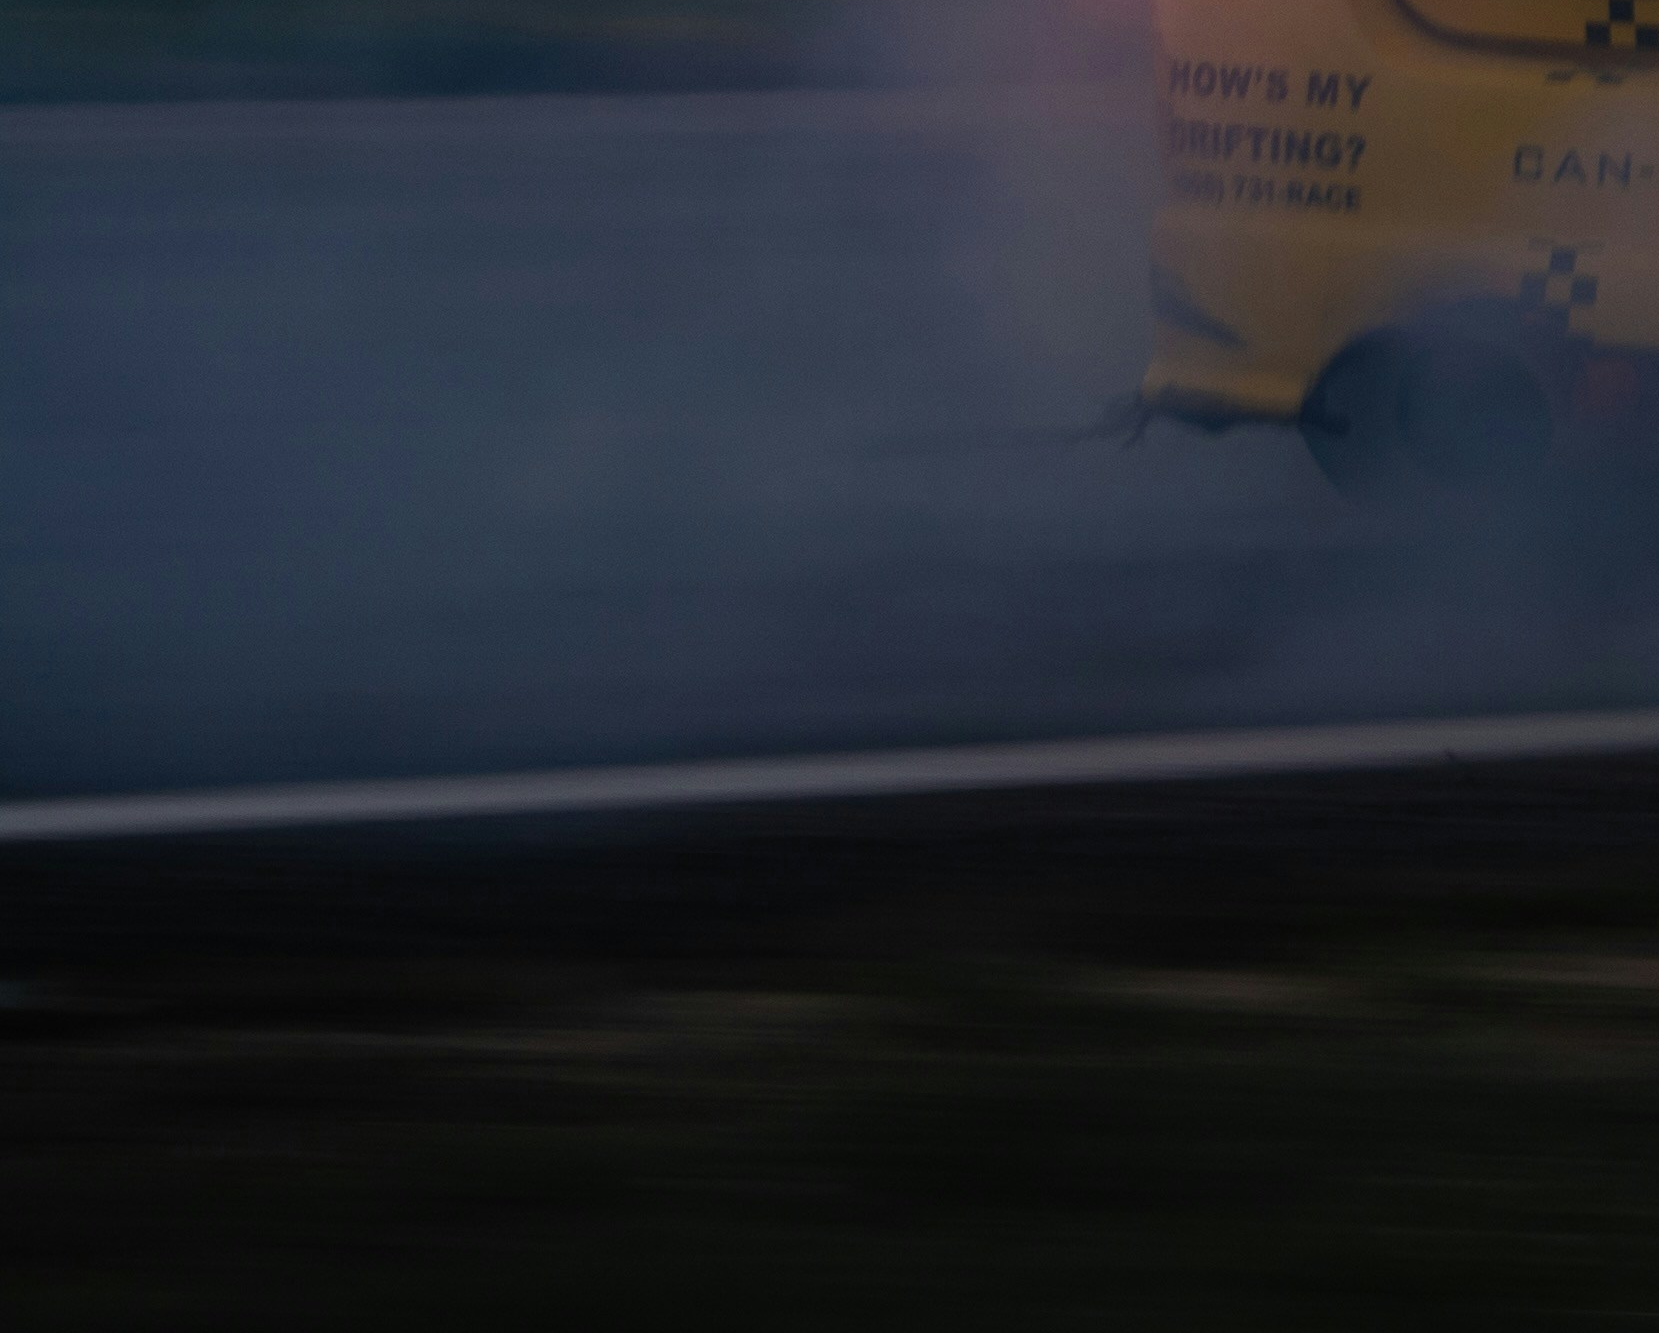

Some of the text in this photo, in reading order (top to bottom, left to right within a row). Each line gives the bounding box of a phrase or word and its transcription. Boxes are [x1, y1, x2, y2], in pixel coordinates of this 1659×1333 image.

[1170, 61, 1372, 112] HOW'S MY
[1167, 119, 1367, 173] DRIFTING?
